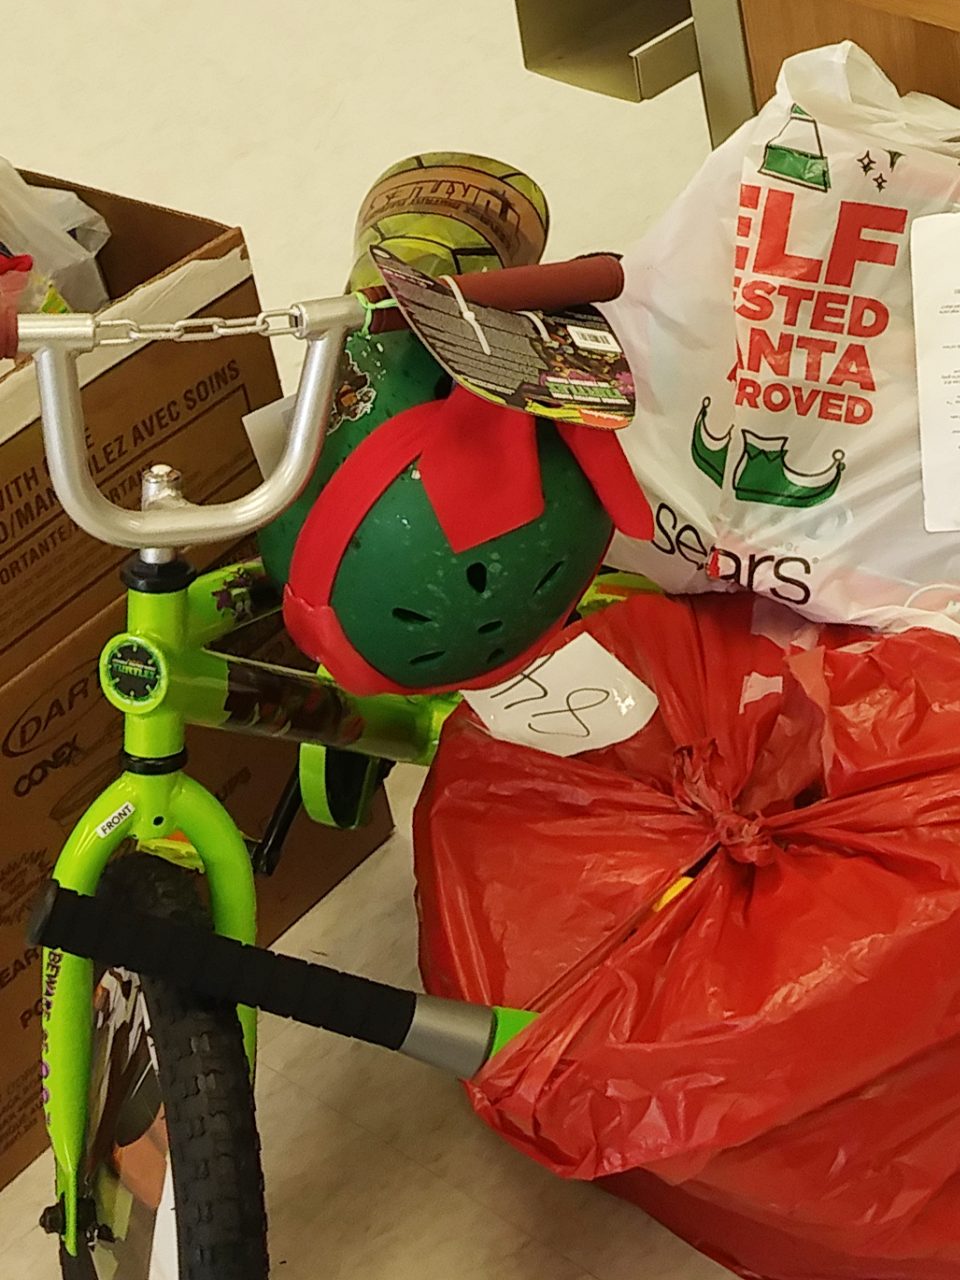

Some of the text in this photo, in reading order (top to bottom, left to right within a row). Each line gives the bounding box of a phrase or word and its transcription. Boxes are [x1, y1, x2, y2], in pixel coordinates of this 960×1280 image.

[732, 276, 890, 338] STED
[735, 326, 877, 393] NTA
[132, 399, 181, 449] AVEC
[183, 358, 241, 412] SOINS
[734, 377, 874, 426] ROVED
[100, 804, 133, 835] FRONT
